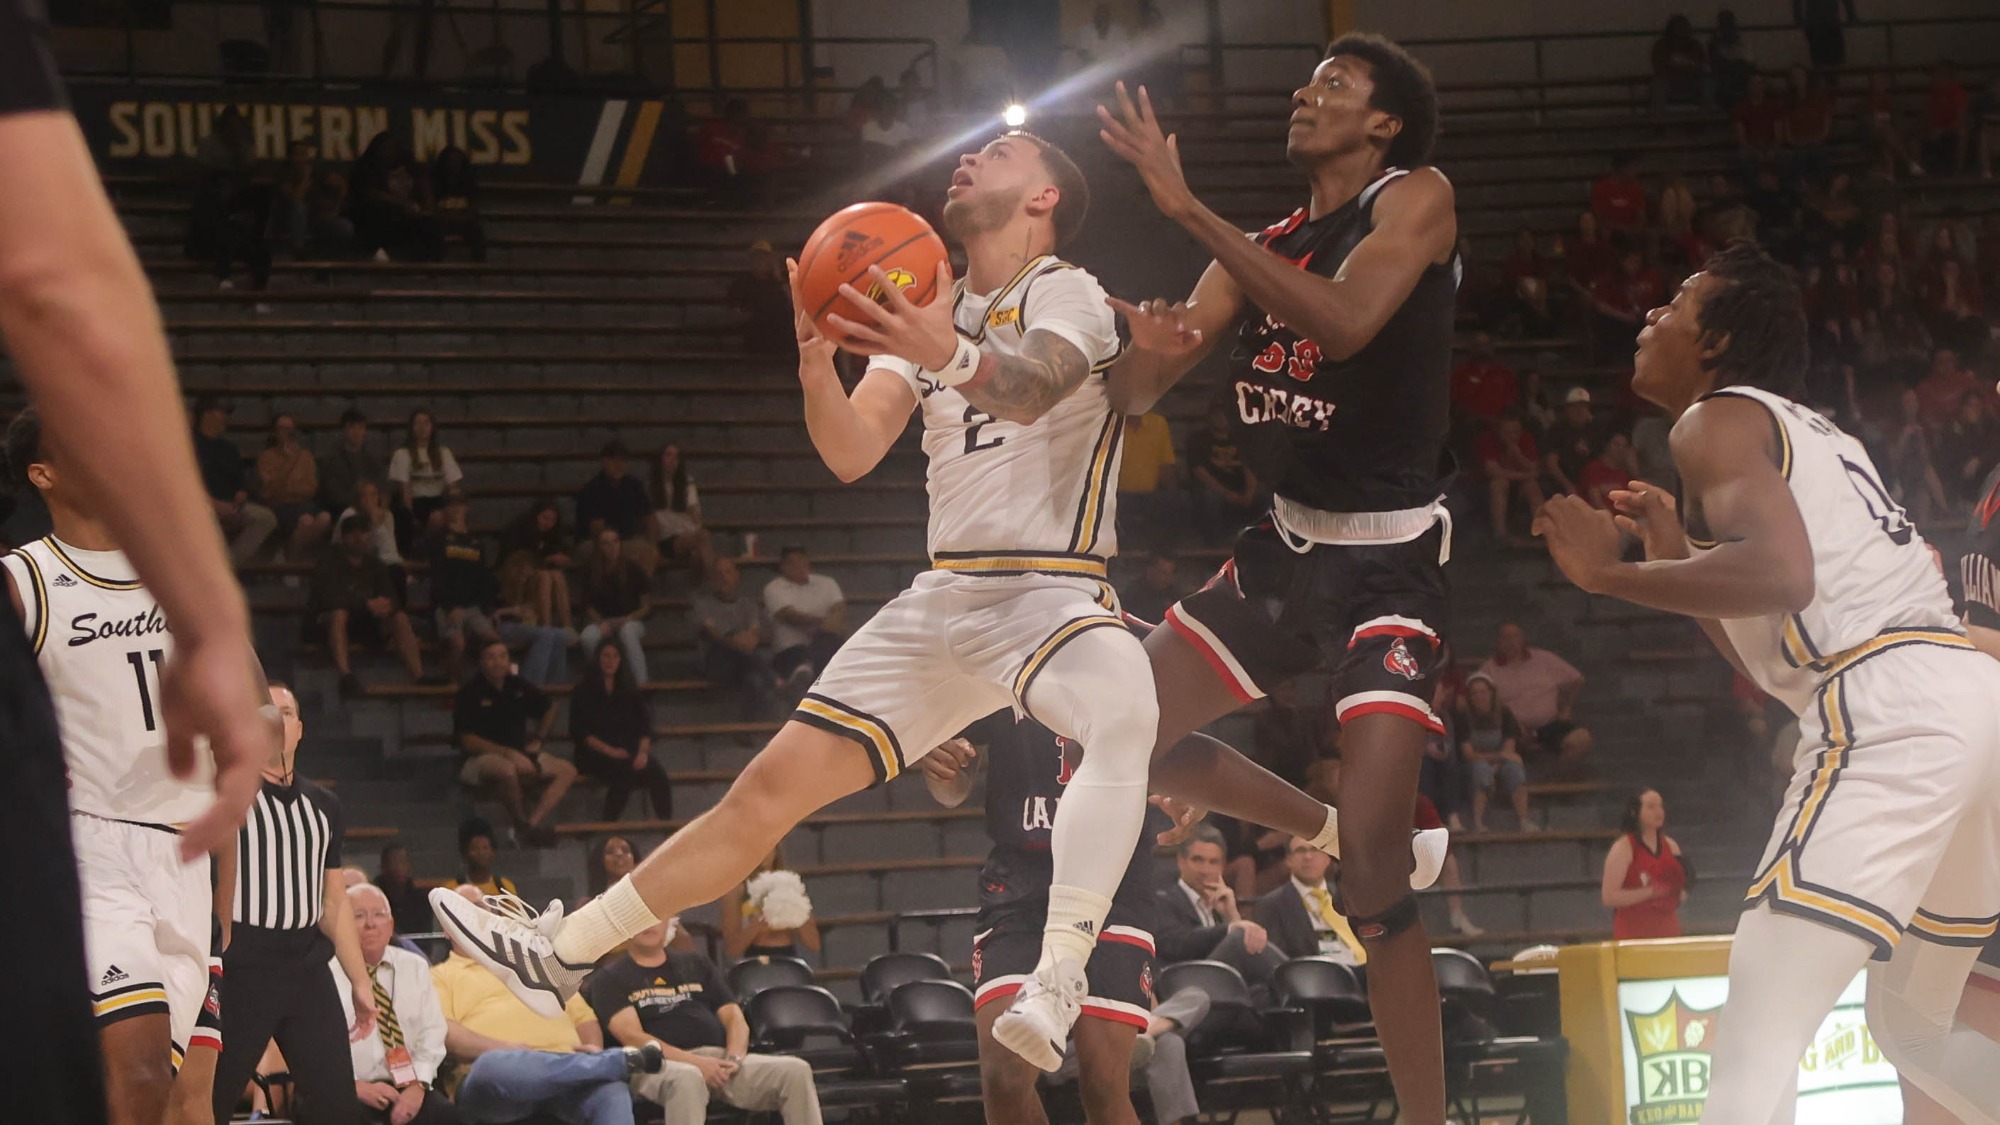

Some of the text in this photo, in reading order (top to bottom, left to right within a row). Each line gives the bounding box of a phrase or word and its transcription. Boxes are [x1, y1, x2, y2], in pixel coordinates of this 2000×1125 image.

[108, 101, 532, 165] SOUHERN MISS
[963, 405, 1006, 455] 2
[101, 973, 129, 986] adidas
